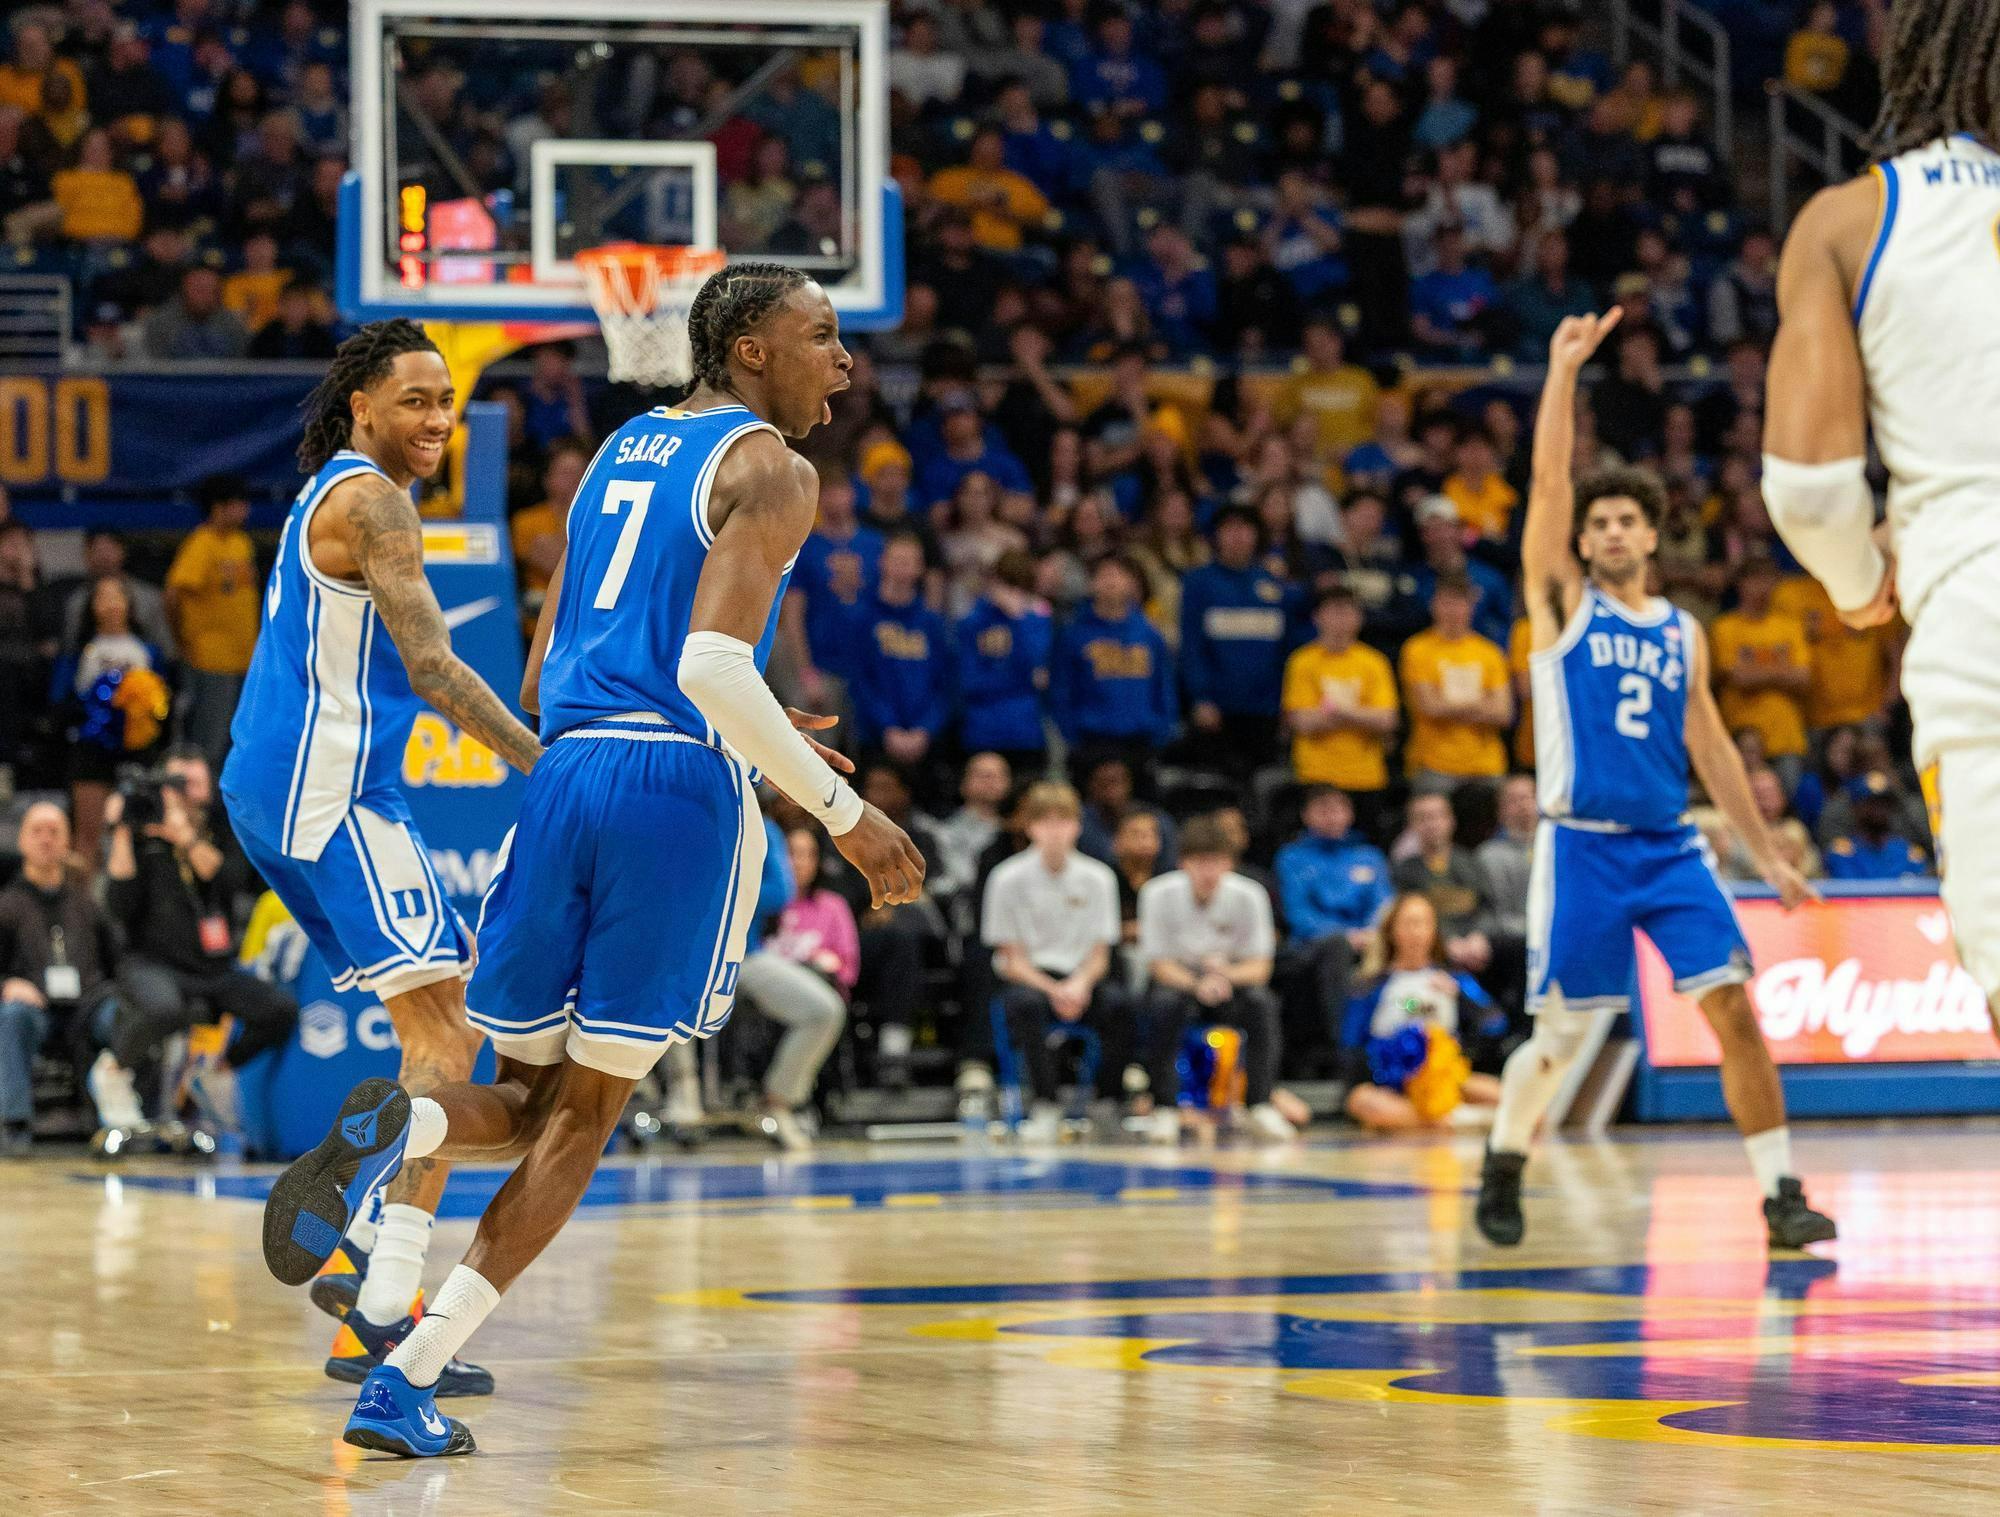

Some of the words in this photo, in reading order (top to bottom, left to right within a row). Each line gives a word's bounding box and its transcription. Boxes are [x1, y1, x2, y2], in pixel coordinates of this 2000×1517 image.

[615, 433, 683, 467] SARR
[593, 479, 656, 610] 7
[1587, 631, 1683, 692] DUKE
[1615, 673, 1653, 740] 2
